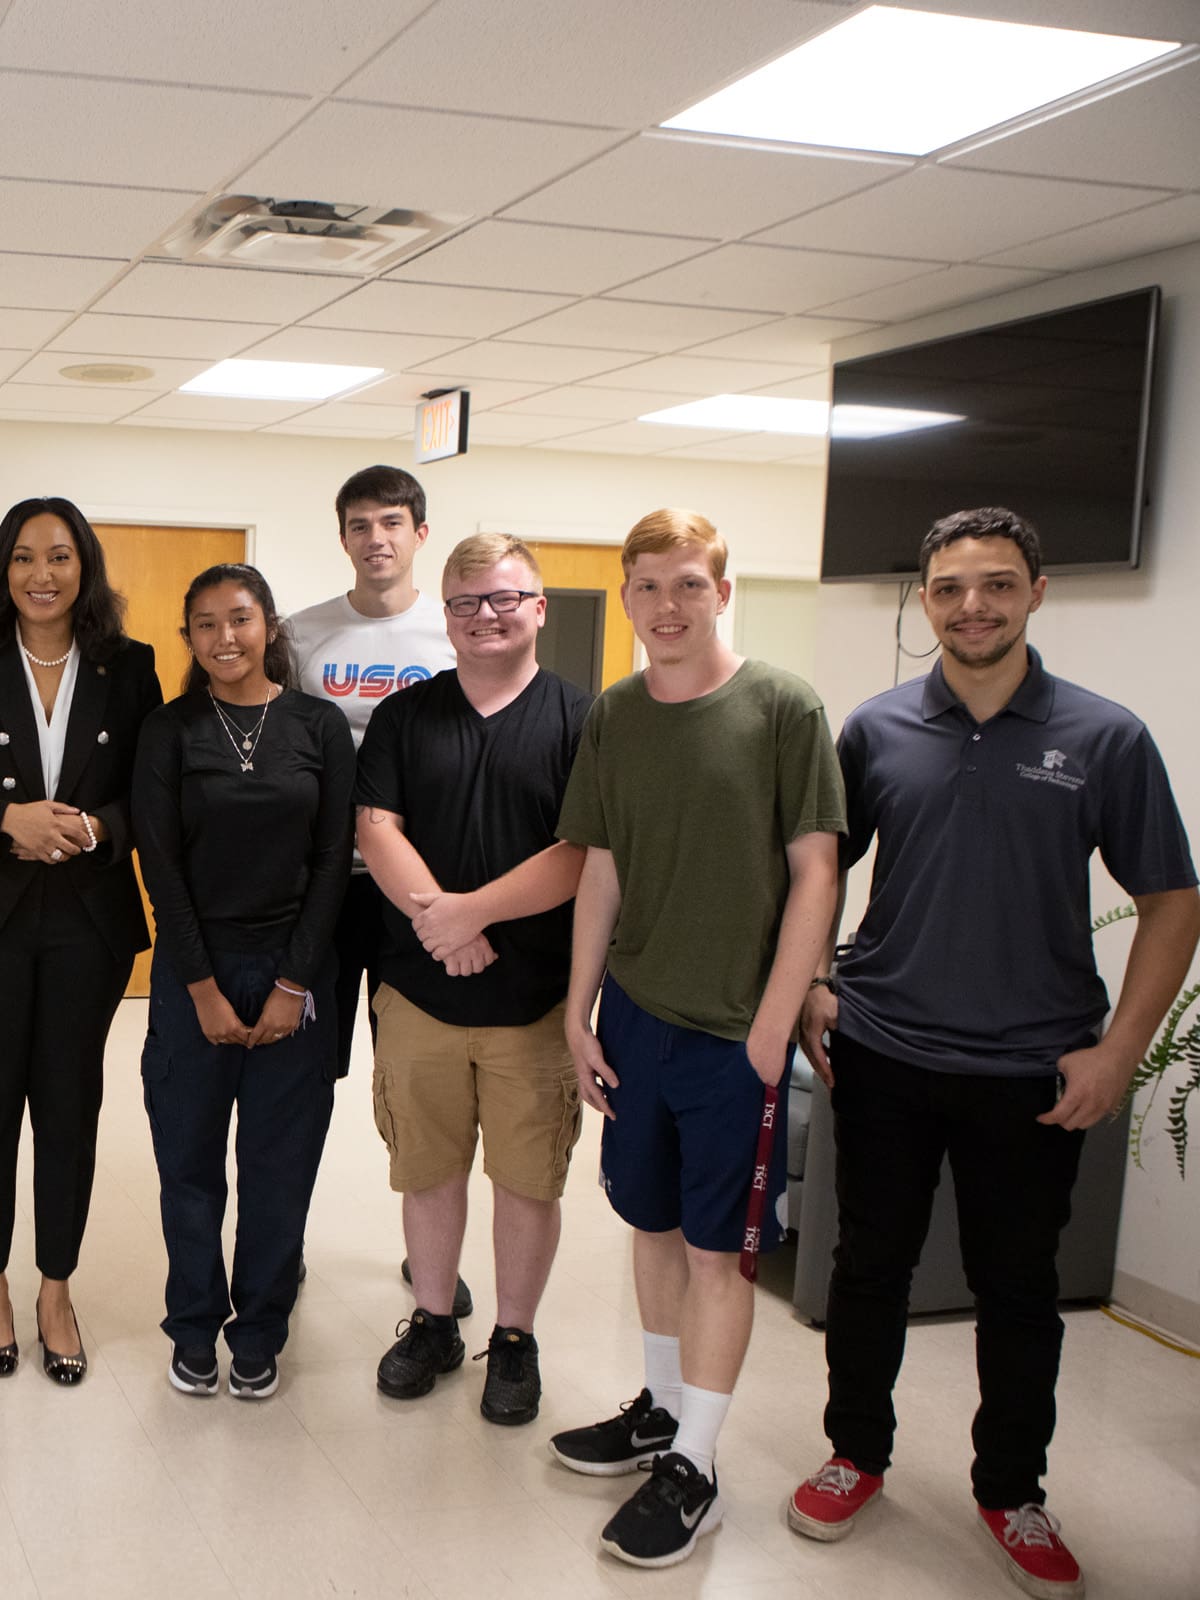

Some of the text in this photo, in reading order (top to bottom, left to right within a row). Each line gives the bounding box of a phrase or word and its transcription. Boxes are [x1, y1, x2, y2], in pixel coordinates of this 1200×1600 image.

[422, 400, 452, 451] EXIT
[1055, 771, 1085, 785] Stevens
[762, 1102, 776, 1130] TSCT
[753, 1164, 766, 1191] TSCT
[743, 1226, 757, 1253] TSCT
